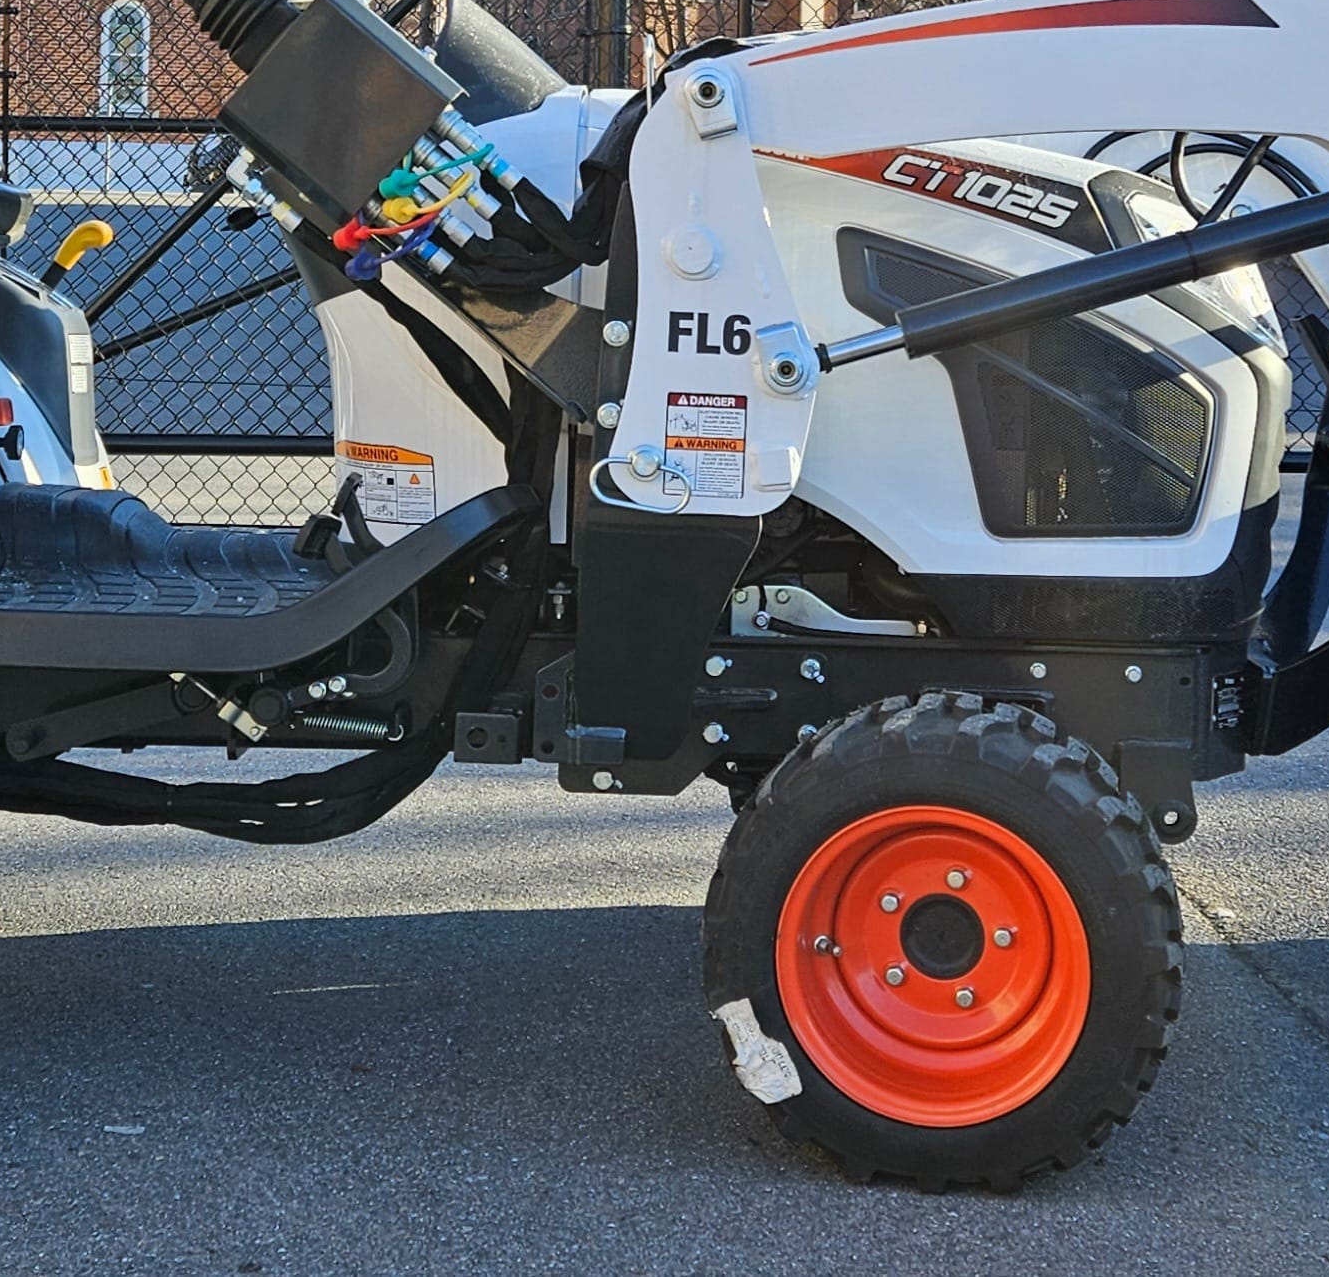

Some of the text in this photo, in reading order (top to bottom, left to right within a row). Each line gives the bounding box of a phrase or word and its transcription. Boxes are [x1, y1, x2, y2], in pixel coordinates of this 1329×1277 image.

[881, 153, 1079, 229] CT1025
[667, 311, 751, 355] FL6
[689, 395, 736, 408] DANGER
[686, 439, 737, 450] WARNING
[351, 445, 399, 462] WARNING
